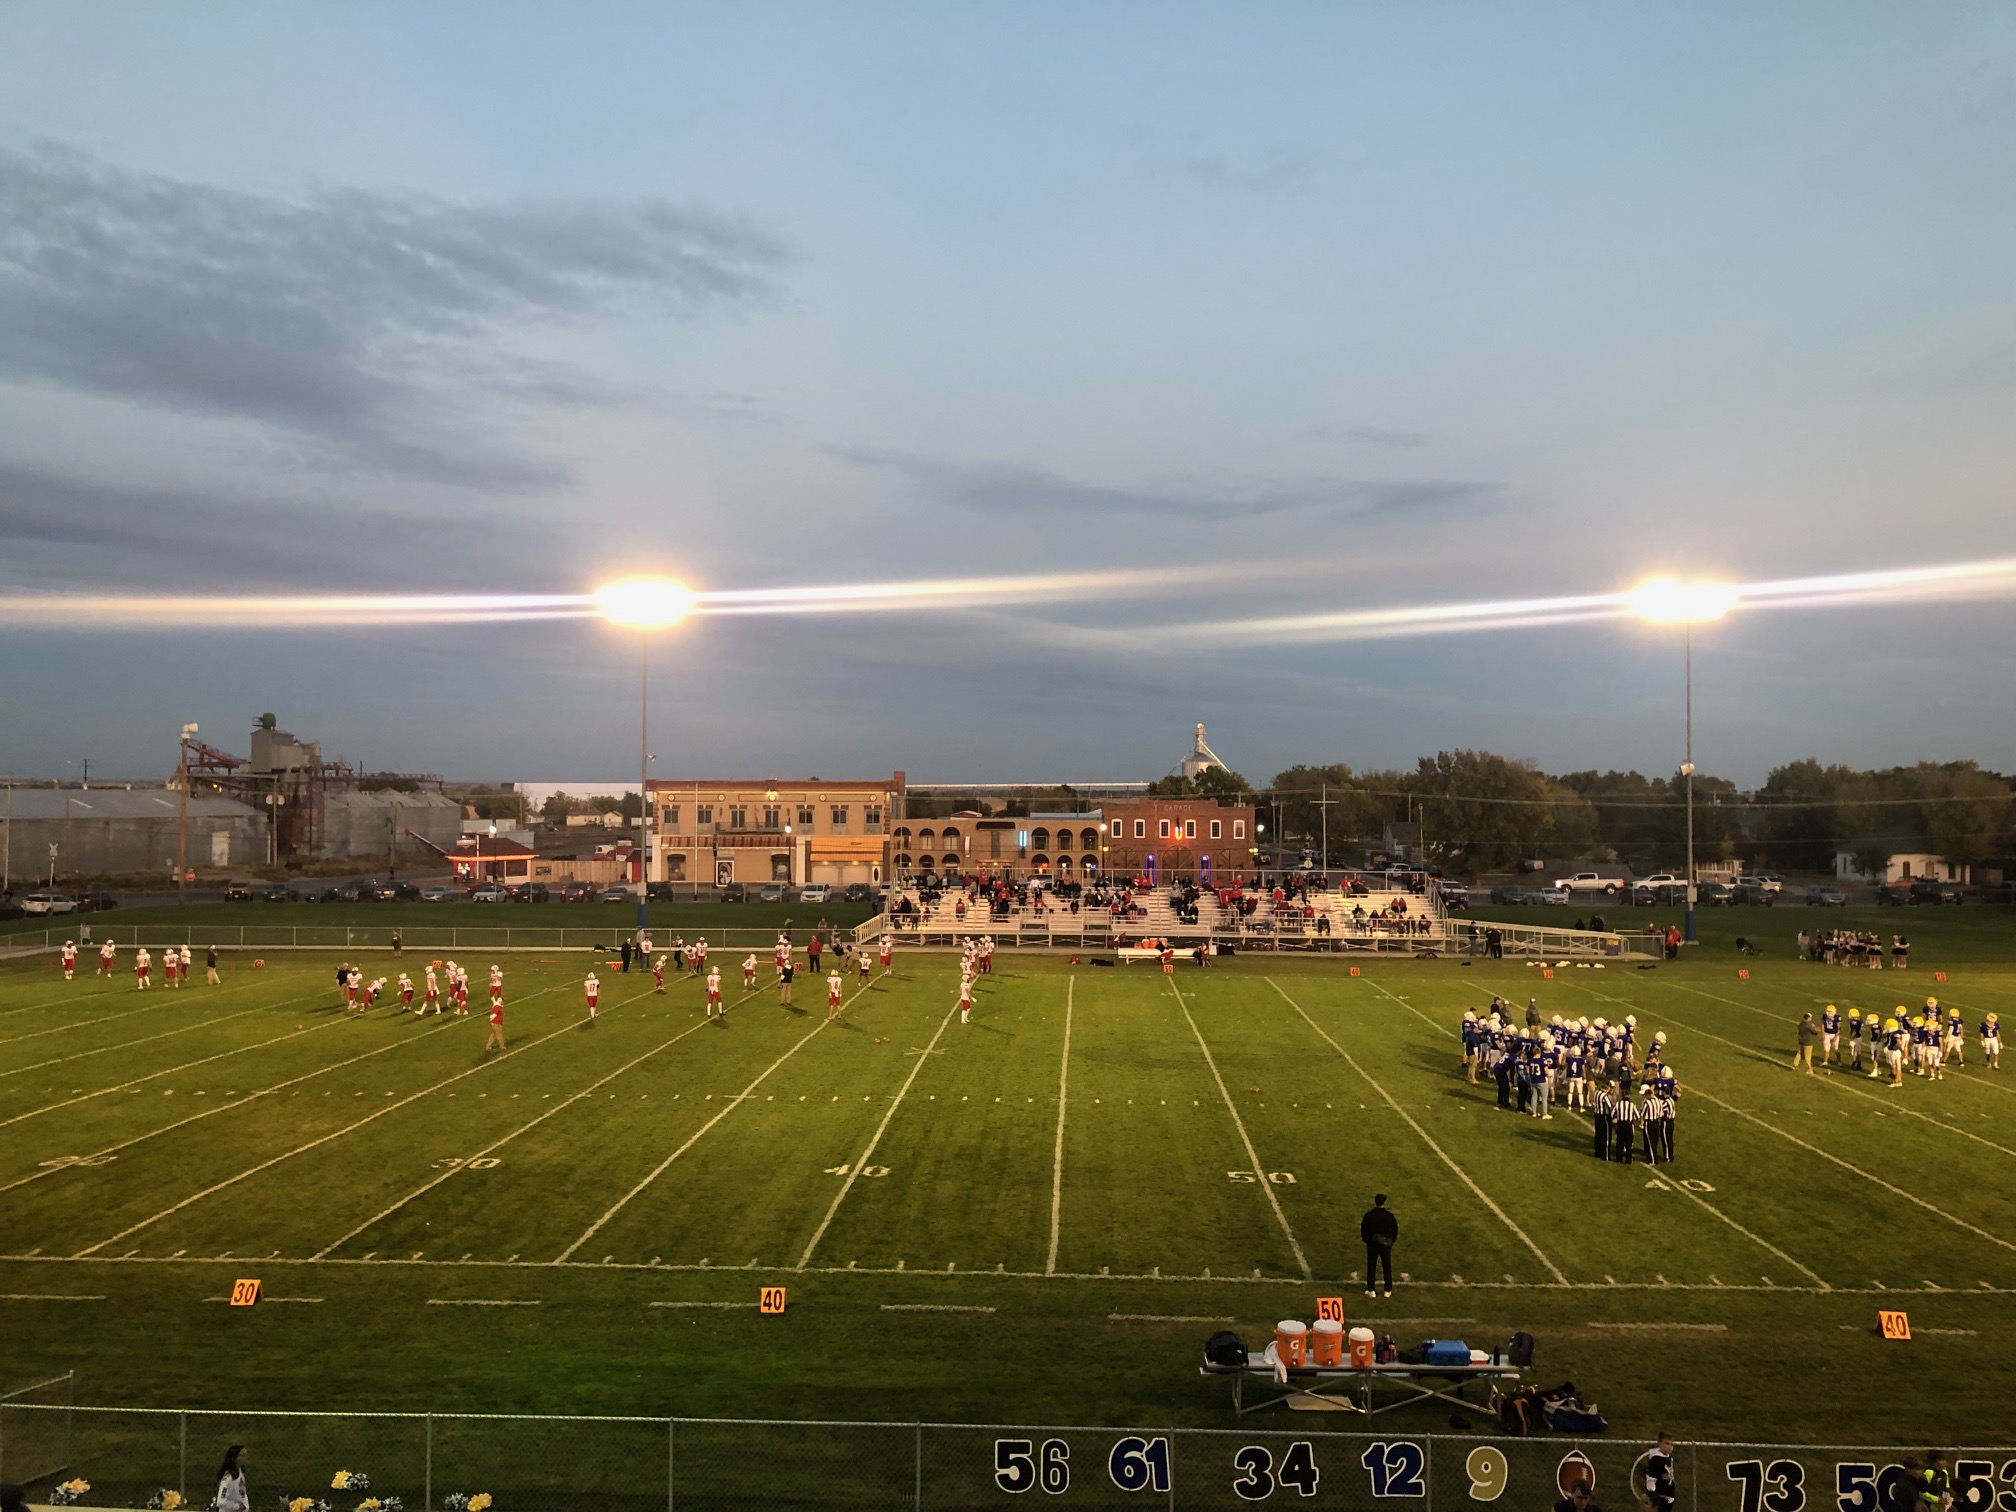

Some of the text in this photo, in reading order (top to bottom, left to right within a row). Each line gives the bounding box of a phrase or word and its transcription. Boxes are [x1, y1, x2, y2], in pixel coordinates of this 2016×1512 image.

[1826, 1021, 1834, 1029] 12
[1530, 1063, 1541, 1075] 73
[1226, 1171, 1297, 1183] 50
[233, 1282, 255, 1304] 30
[762, 1289, 783, 1311] 40
[1320, 1300, 1341, 1322] 50
[1885, 1314, 1907, 1337] 40
[1290, 1340, 1300, 1350] G
[1356, 1345, 1367, 1357] G
[995, 1438, 1070, 1494] 56
[1109, 1436, 1171, 1491] 61
[1233, 1441, 1319, 1500] 34
[1361, 1441, 1425, 1497] 12
[1466, 1445, 1508, 1501] 9
[1726, 1459, 1806, 1512] 73
